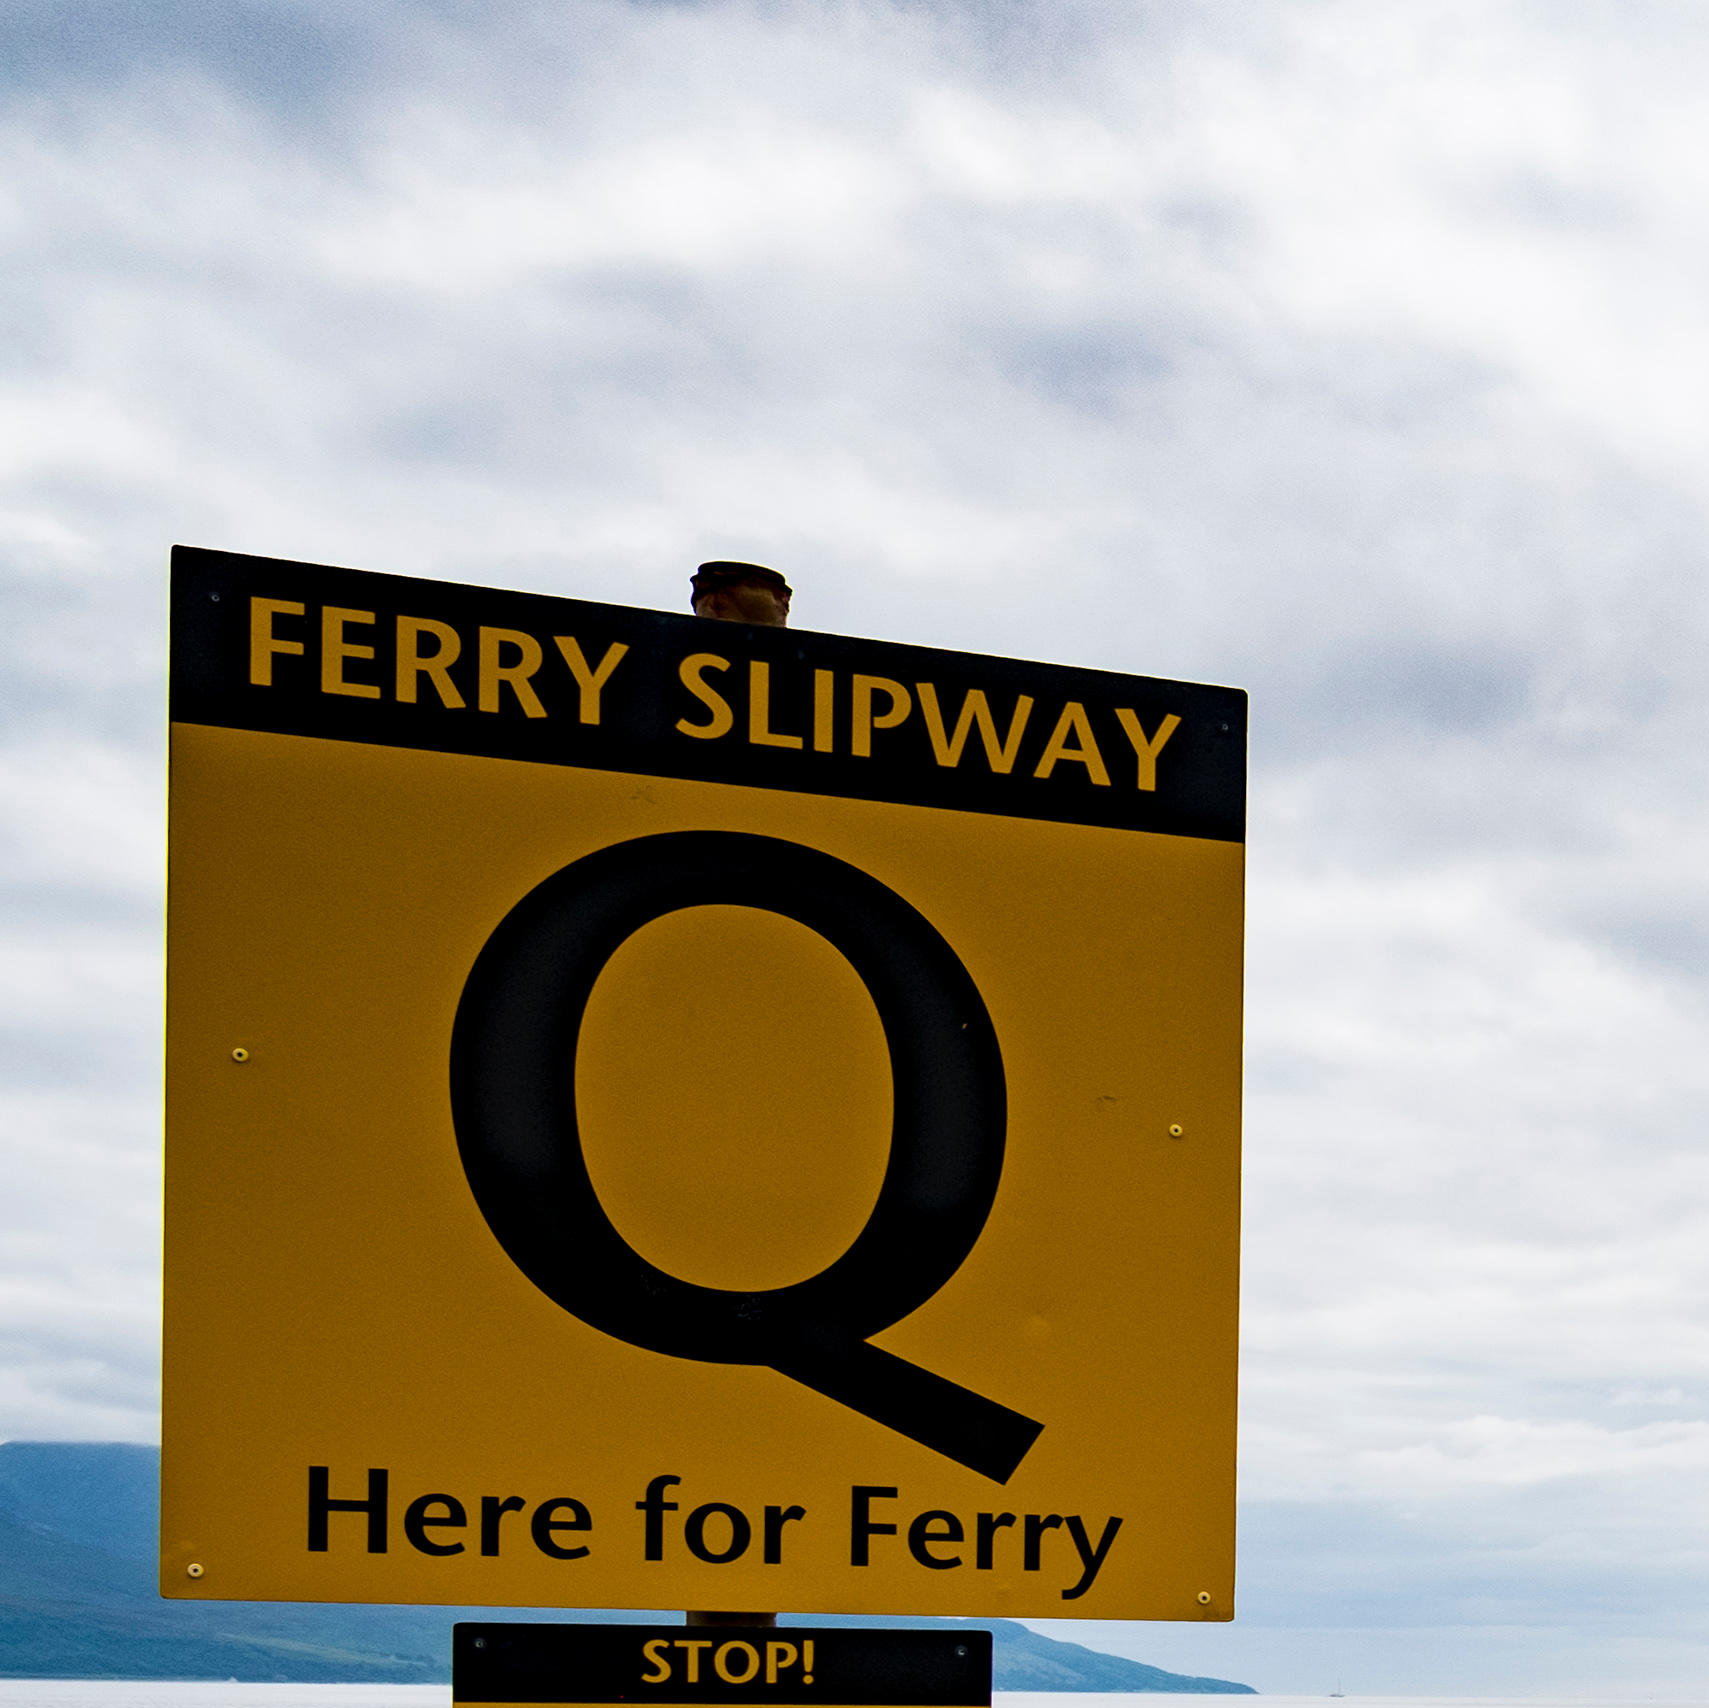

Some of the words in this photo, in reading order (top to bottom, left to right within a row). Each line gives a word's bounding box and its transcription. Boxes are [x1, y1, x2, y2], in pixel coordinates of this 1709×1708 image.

[251, 597, 629, 725] FERRY
[676, 654, 1181, 791] SLIPWAY
[449, 830, 1045, 1485] Q
[308, 1466, 592, 1559] Here
[636, 1475, 806, 1564] for
[851, 1486, 1123, 1600] Ferry
[642, 1640, 813, 1684] STOP!
